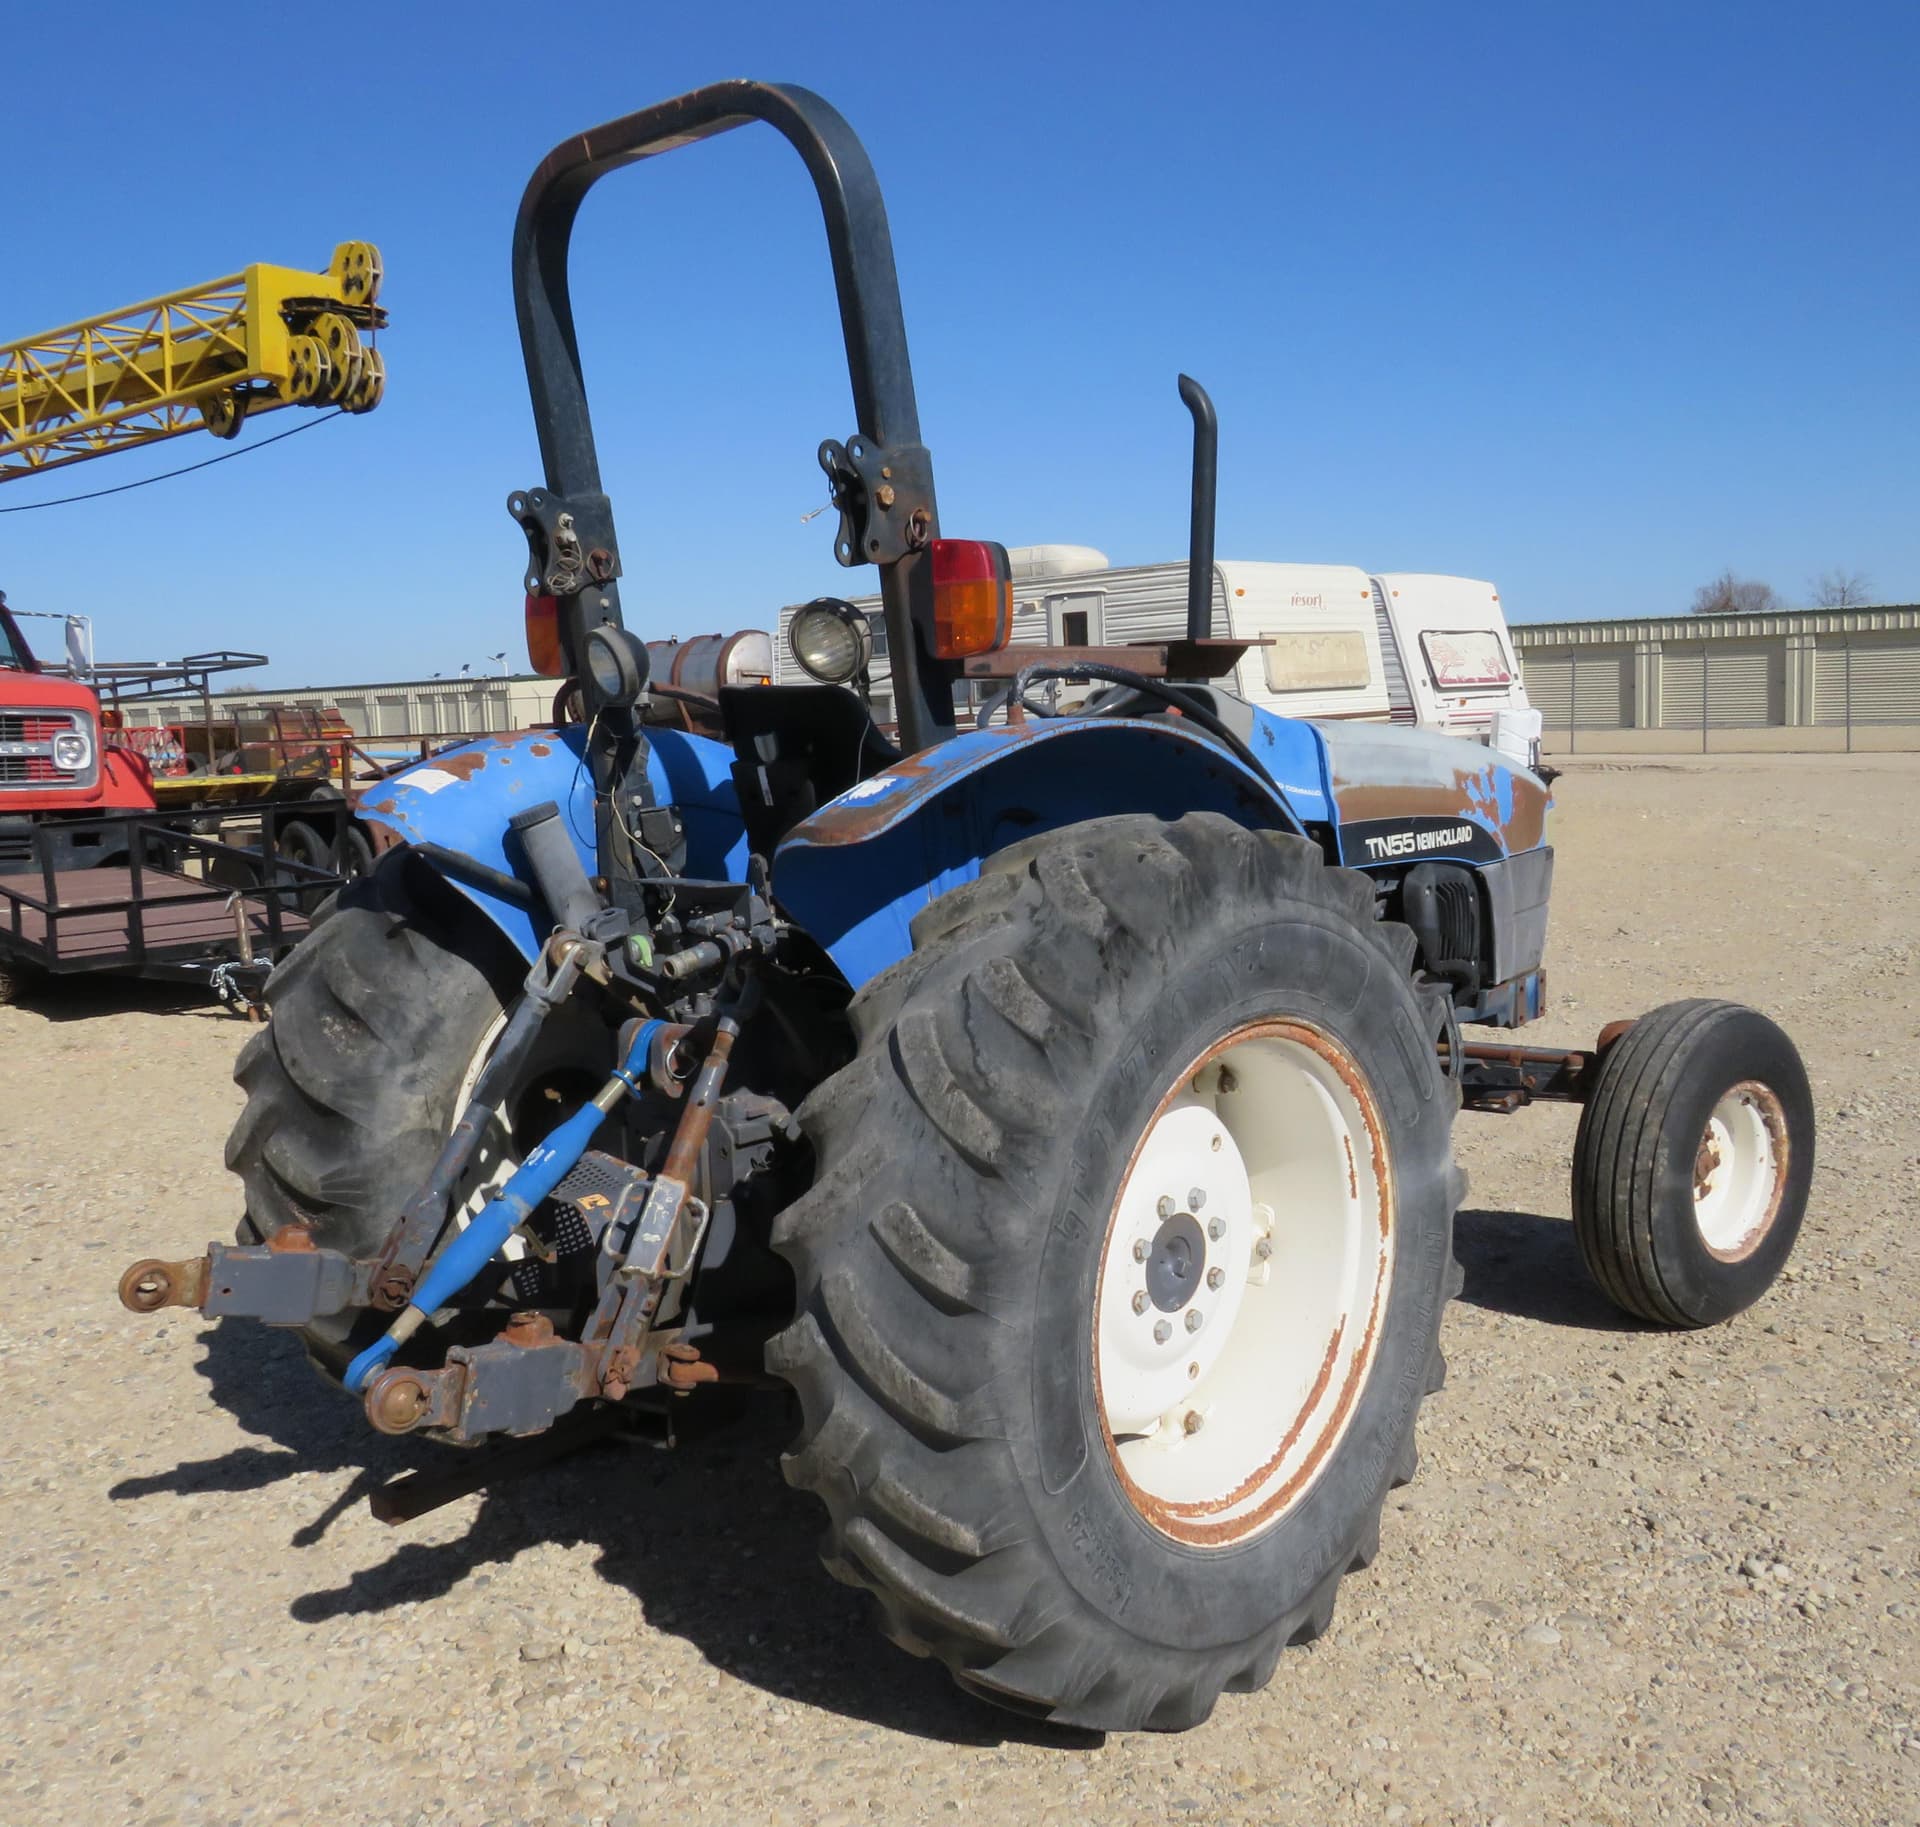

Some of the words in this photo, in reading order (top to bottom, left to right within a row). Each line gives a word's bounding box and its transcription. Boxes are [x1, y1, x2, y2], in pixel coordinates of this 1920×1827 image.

[1365, 832, 1416, 859] TN55
[1416, 831, 1436, 851] NEW
[1436, 825, 1473, 846] HOLLAND
